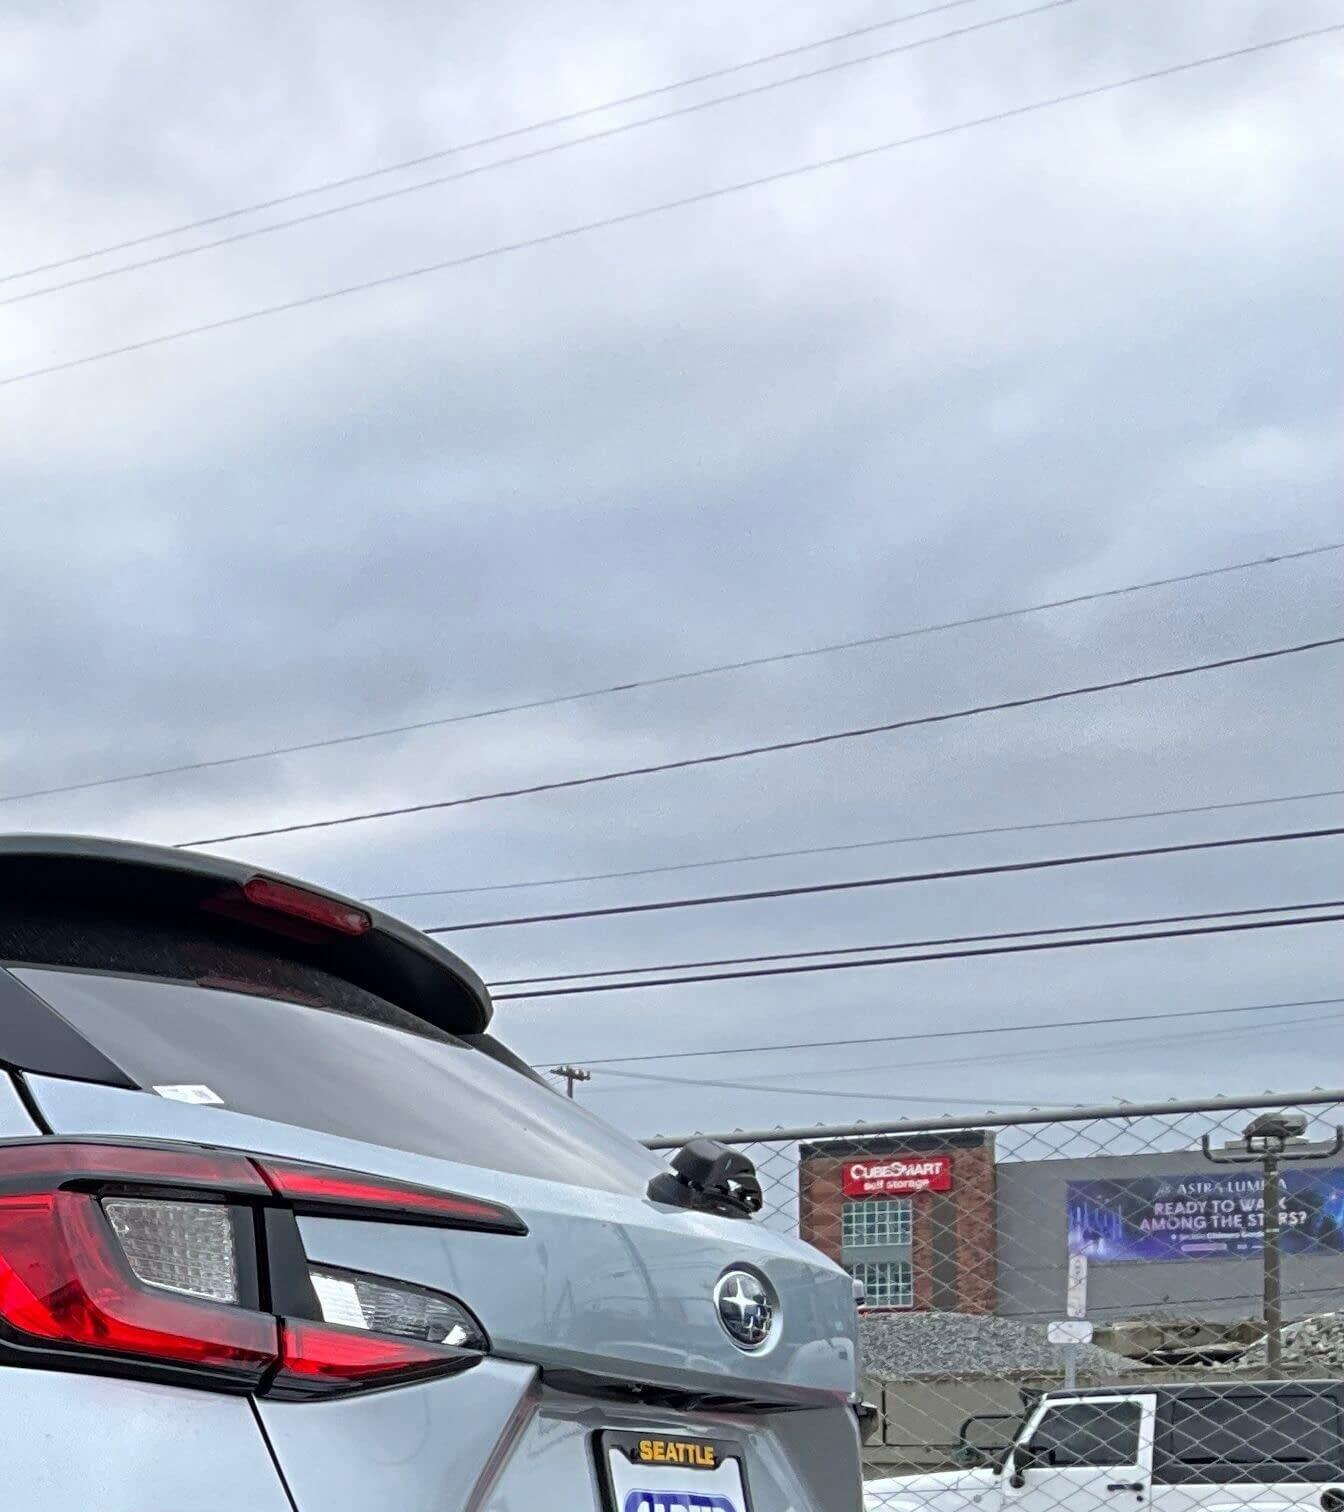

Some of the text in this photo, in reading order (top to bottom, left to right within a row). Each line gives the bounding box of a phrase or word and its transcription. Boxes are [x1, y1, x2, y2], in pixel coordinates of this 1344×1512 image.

[1154, 1197, 1287, 1216] READY TO WAK
[1140, 1211, 1307, 1231] AMONG THE STRS?
[639, 1440, 715, 1465] SEATTLE
